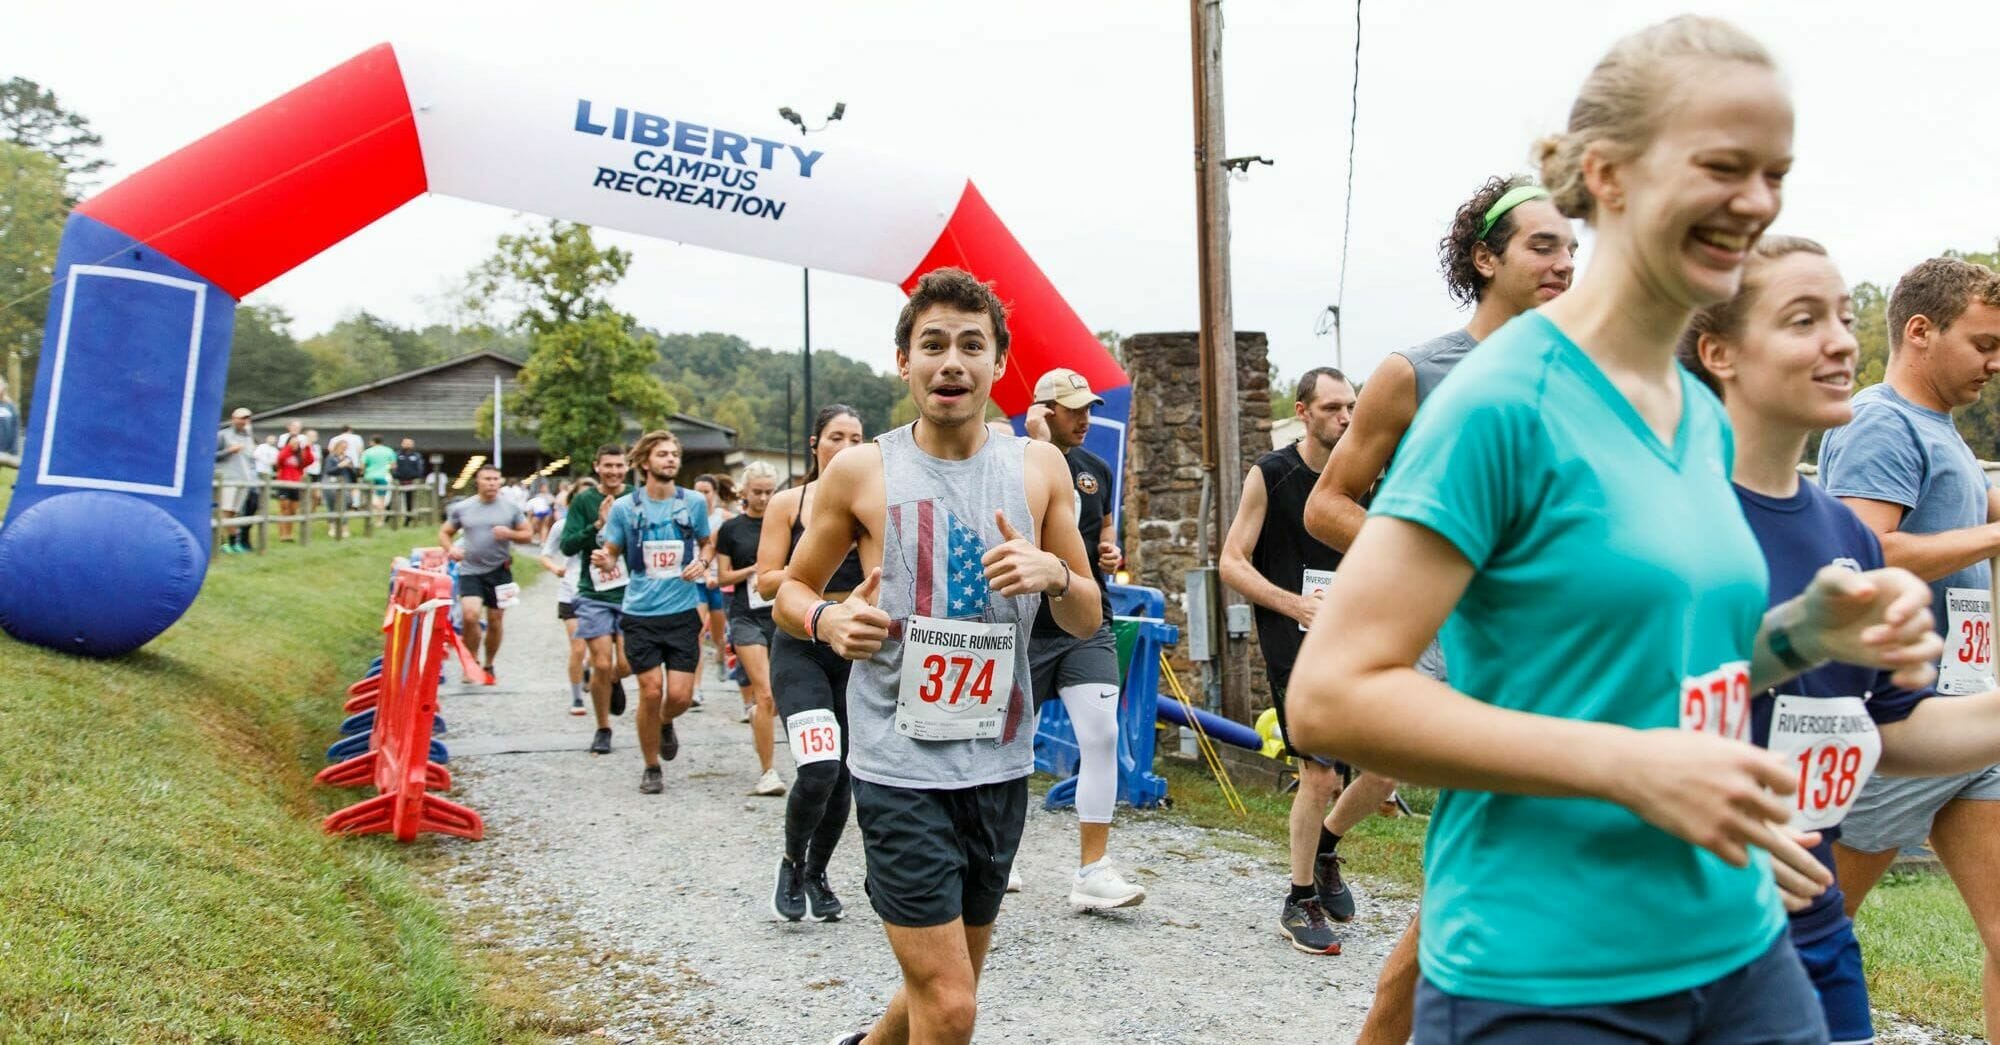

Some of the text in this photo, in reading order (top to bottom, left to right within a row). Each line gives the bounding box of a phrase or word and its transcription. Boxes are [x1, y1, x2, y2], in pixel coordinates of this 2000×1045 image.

[574, 98, 824, 178] LIBERTY
[634, 150, 758, 191] CAMPUS
[593, 167, 786, 220] RECREATION
[653, 552, 676, 568] 192
[1950, 599, 1980, 612] RIVERSIDE
[910, 627, 1013, 650] RIVERSIDE RUNNERS
[919, 654, 995, 705] 374
[800, 727, 834, 754] 153
[1777, 713, 1838, 734] RIVERSIDE
[1797, 745, 1862, 810] 138
